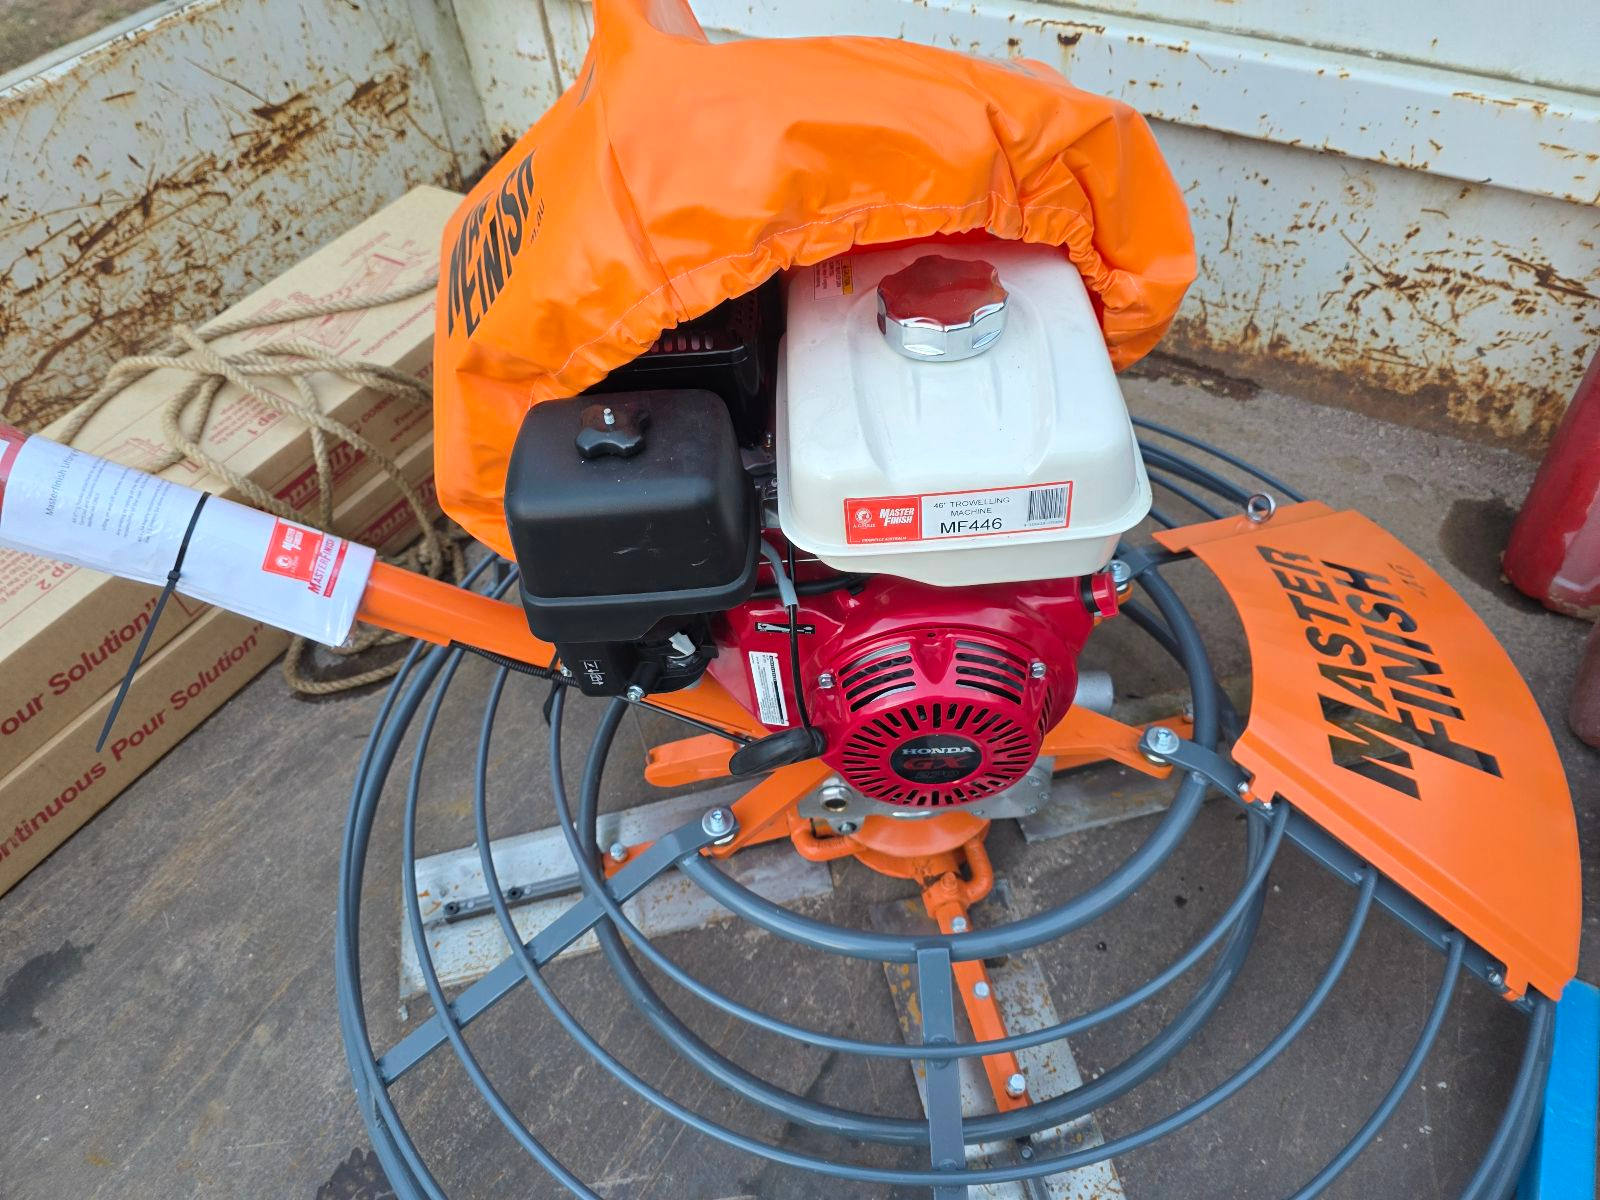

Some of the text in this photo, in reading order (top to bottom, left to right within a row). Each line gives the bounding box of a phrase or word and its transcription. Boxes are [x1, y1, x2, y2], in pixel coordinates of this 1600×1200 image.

[949, 496, 1010, 508] TROWELLING
[880, 507, 915, 519] MASTER
[950, 508, 992, 517] MACHINE
[883, 516, 913, 527] FINISH
[940, 517, 1003, 534] MF446
[1255, 545, 1422, 801] MASTER
[1319, 560, 1504, 779] FINISH
[110, 709, 167, 761] Pour
[902, 746, 977, 755] HONDA
[903, 755, 971, 770] GX
